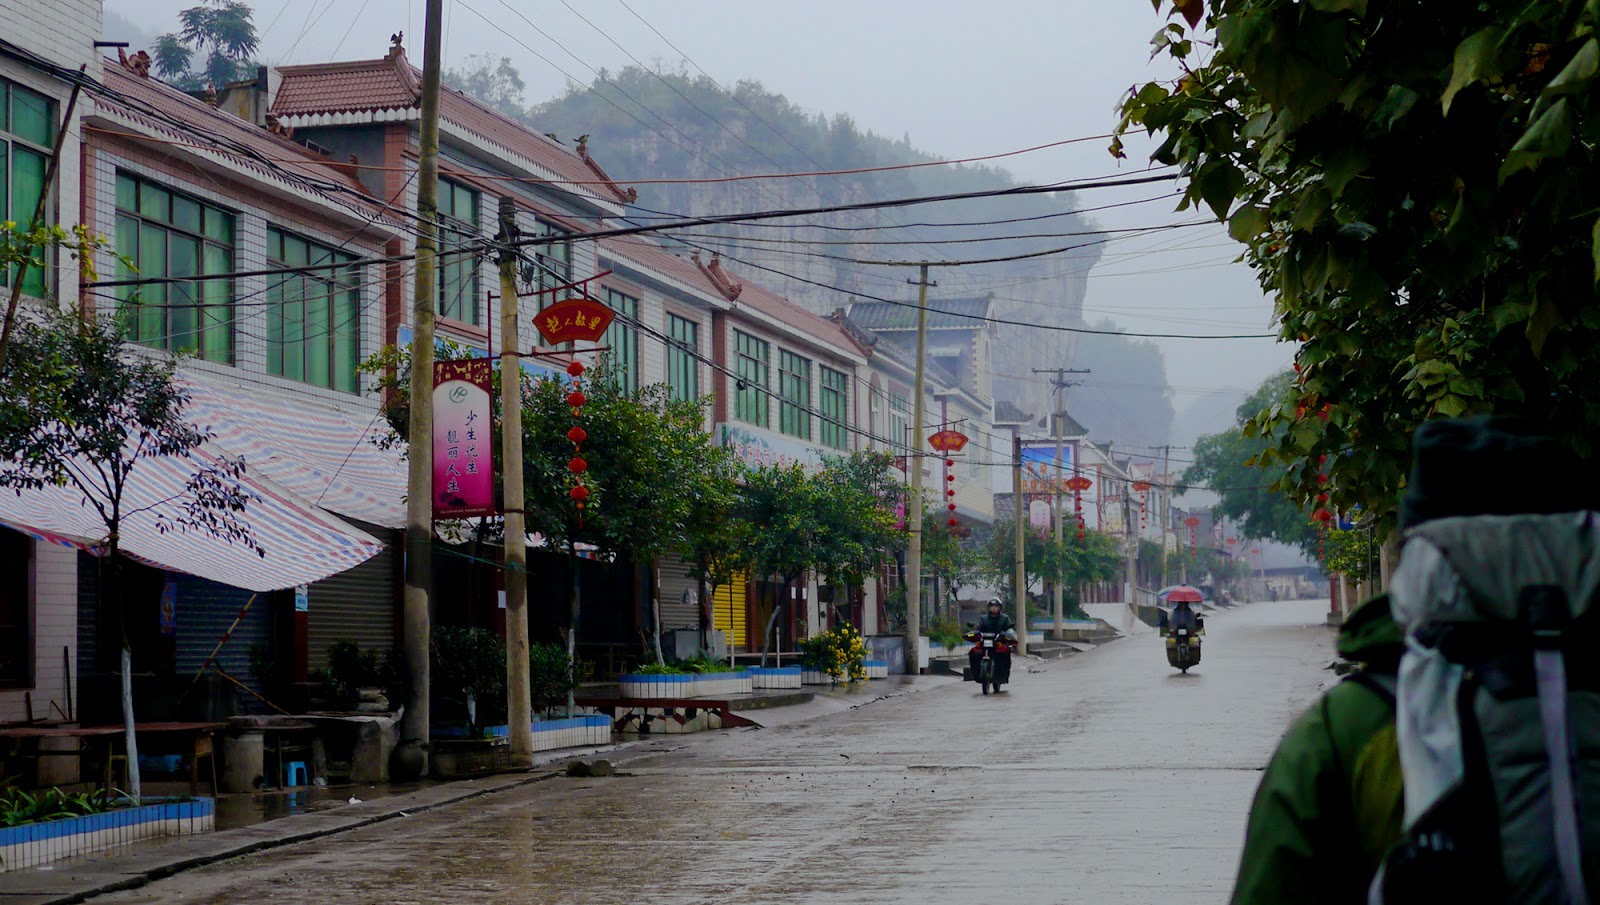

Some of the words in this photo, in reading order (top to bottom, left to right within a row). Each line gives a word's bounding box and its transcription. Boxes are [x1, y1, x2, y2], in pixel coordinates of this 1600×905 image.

[446, 429, 461, 493] 靓丽人生
[464, 410, 478, 474] 少生优生
